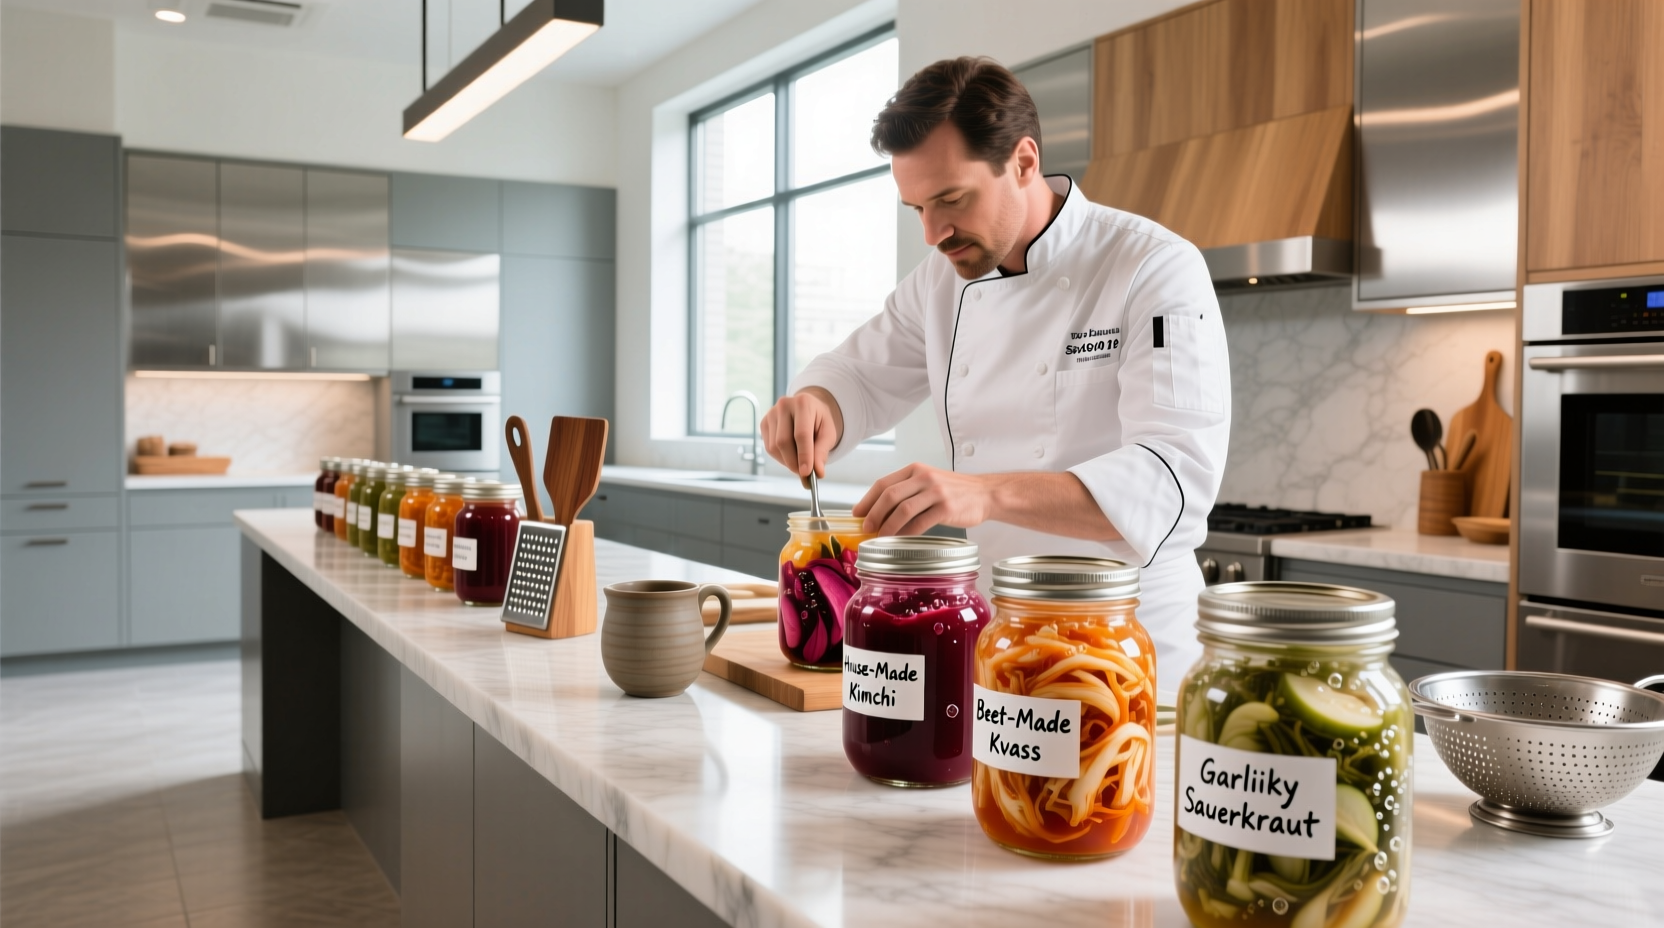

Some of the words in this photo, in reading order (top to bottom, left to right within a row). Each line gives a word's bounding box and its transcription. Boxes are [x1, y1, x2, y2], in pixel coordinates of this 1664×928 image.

[849, 681, 896, 707] Kimchi
[976, 698, 1071, 734] Beet-Made
[989, 731, 1041, 762] Kvass
[1200, 757, 1299, 810] Garliiky
[1184, 785, 1321, 838] Sauerkraut
